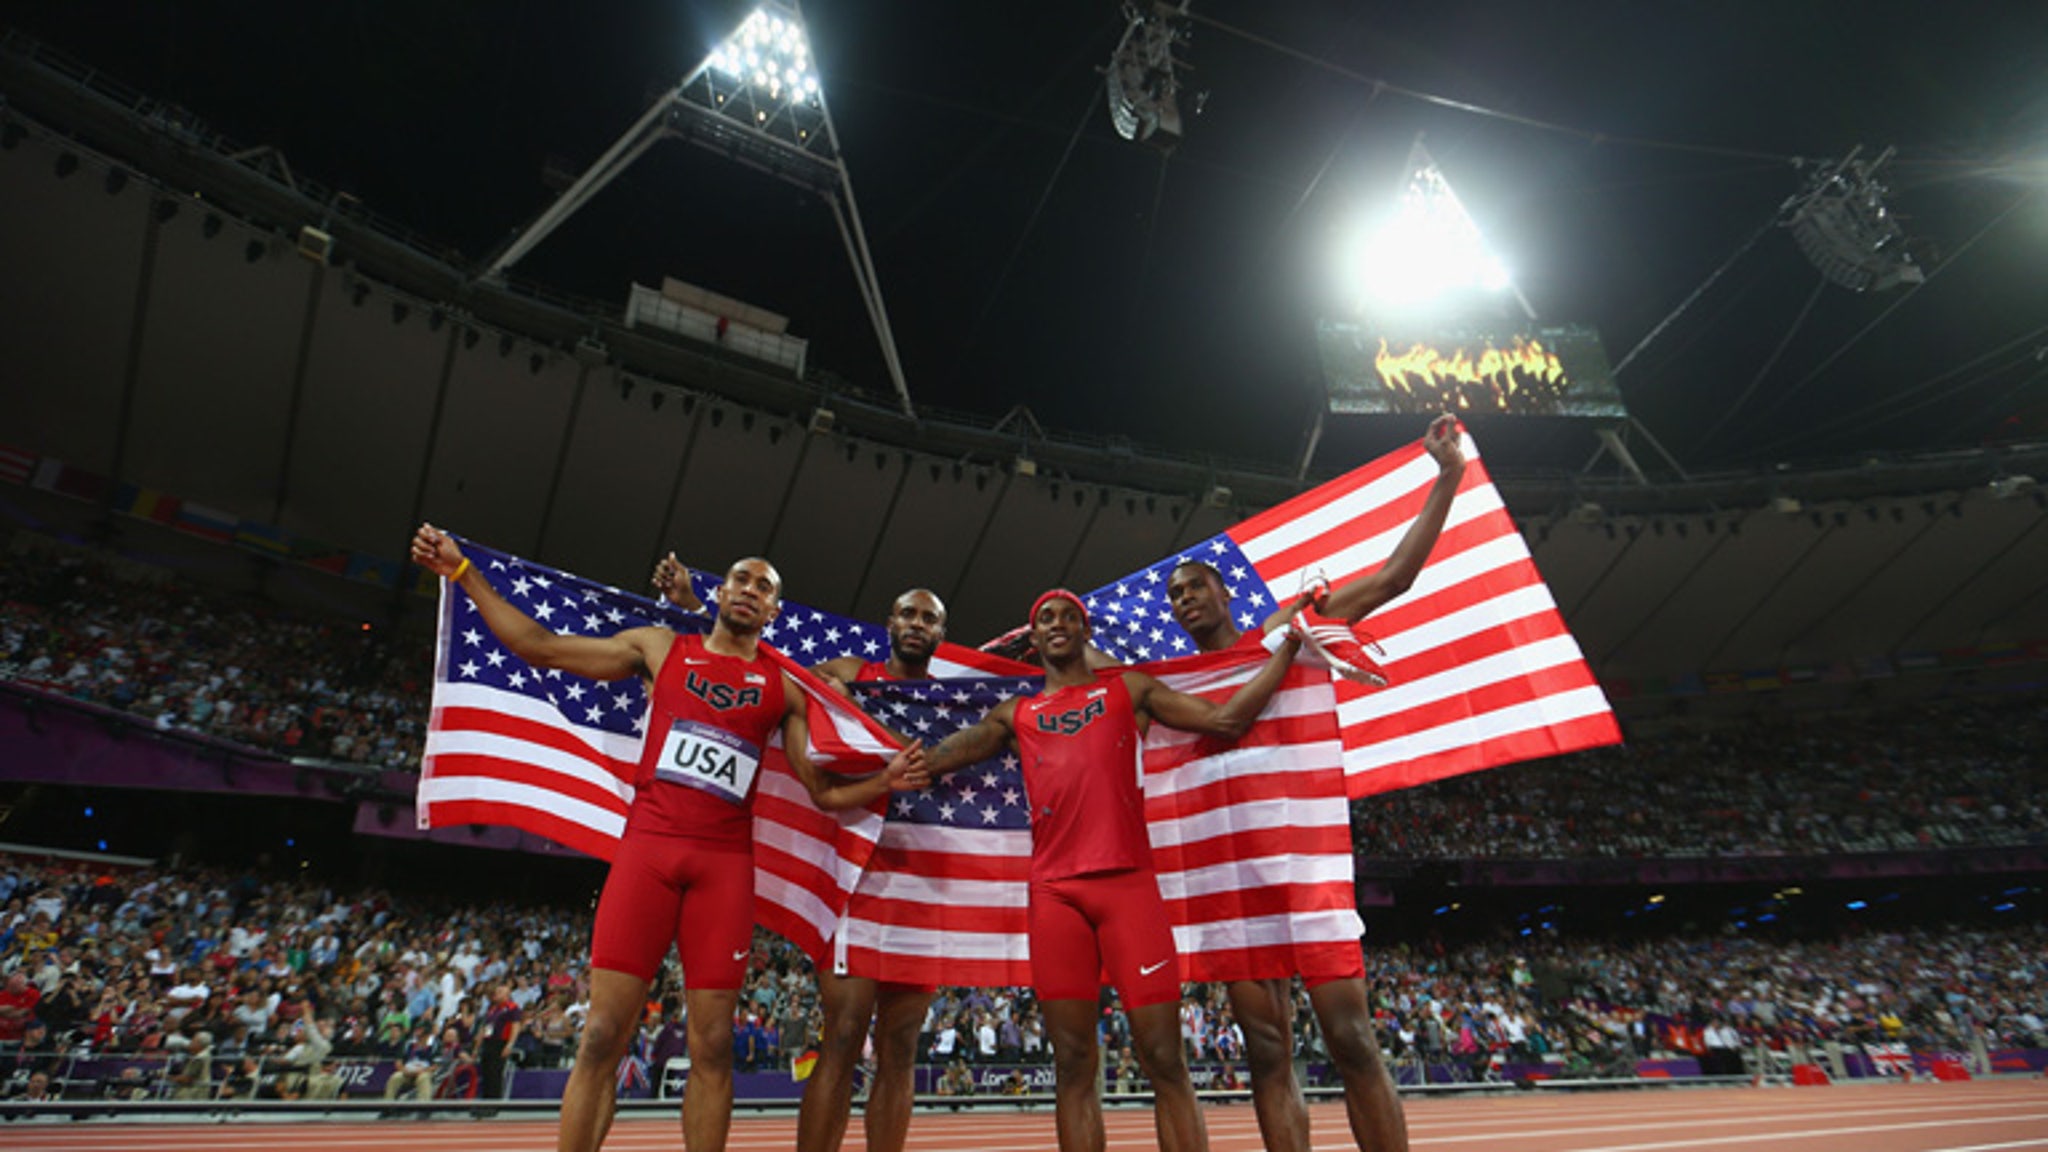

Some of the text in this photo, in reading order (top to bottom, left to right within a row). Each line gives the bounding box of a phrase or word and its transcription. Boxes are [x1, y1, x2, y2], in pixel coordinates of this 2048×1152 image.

[685, 671, 762, 711] USA
[1037, 697, 1106, 736] USA
[674, 739, 738, 787] USA
[335, 1065, 375, 1086] 012
